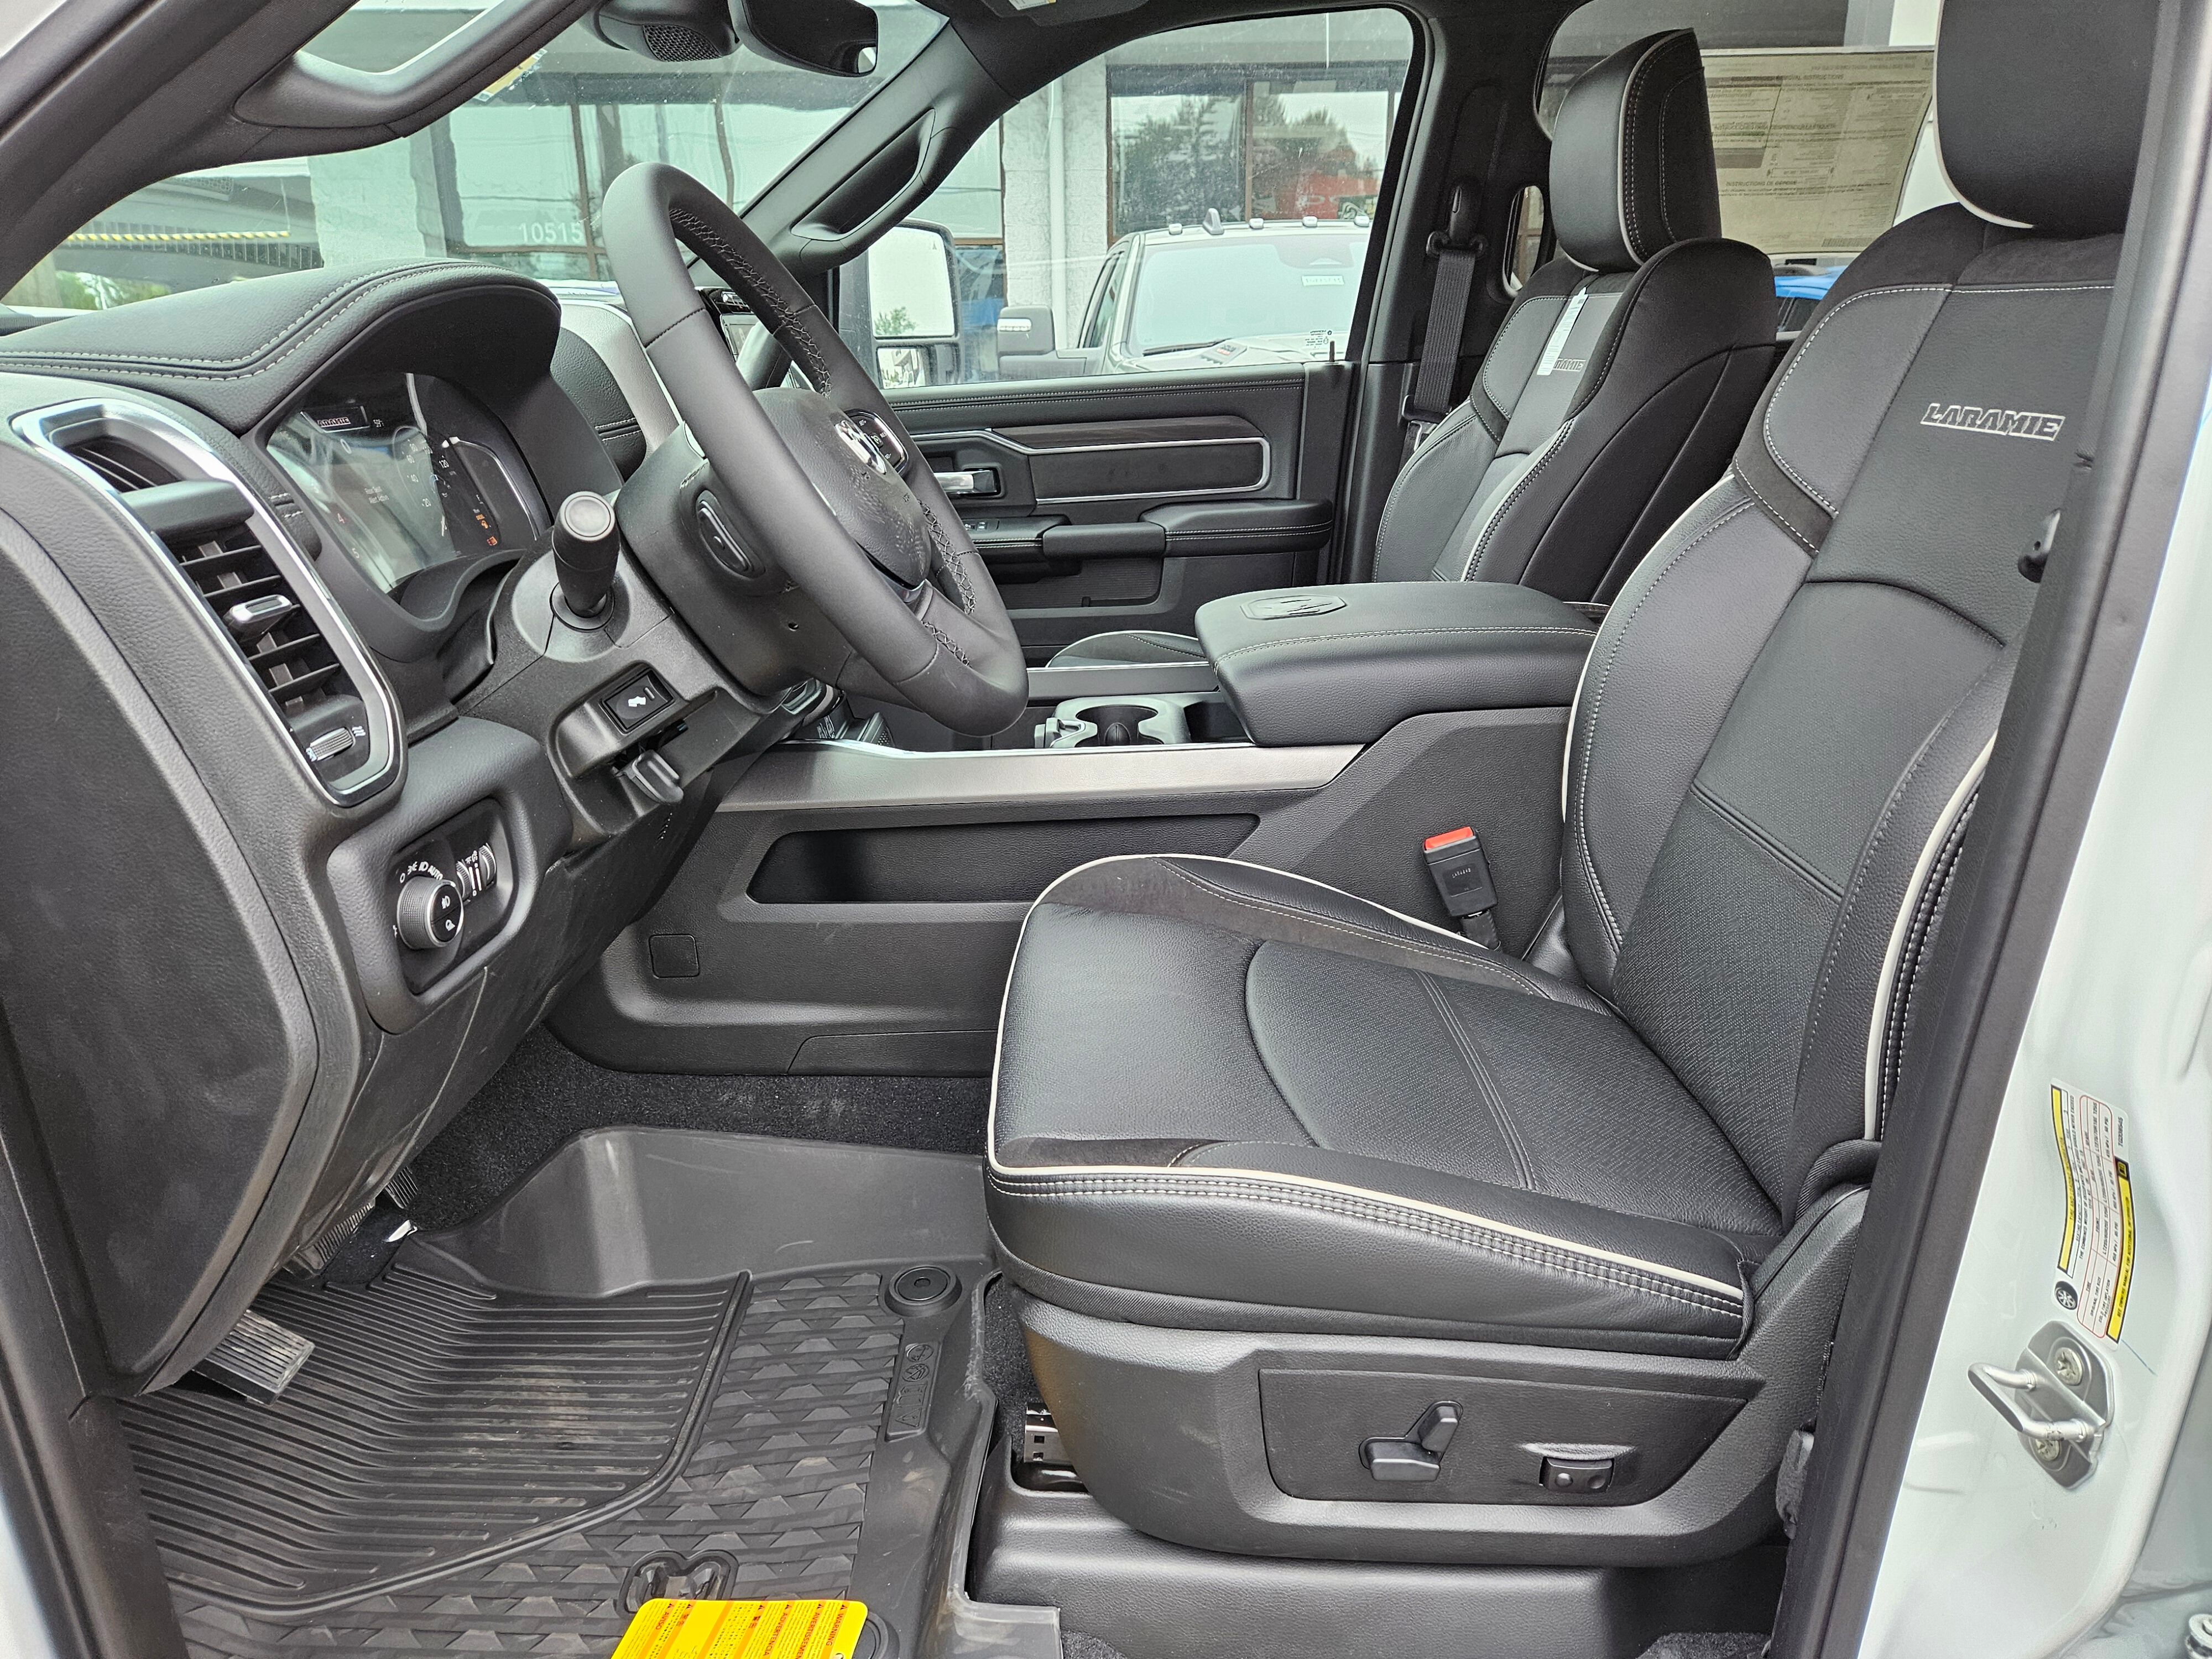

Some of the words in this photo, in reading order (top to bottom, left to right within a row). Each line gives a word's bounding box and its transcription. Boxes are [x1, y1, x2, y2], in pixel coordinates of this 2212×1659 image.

[519, 222, 584, 244] 10515
[1553, 358, 1586, 372] RAMIE
[1919, 403, 2066, 441] LARAMIE
[439, 459, 450, 468] 120
[337, 513, 346, 524] 4
[351, 547, 360, 559] 5
[427, 864, 444, 881] AUTO
[656, 1612, 669, 1630] AVISO
[763, 1613, 787, 1656] ADVERTENCIA
[826, 1614, 844, 1646] WARNING
